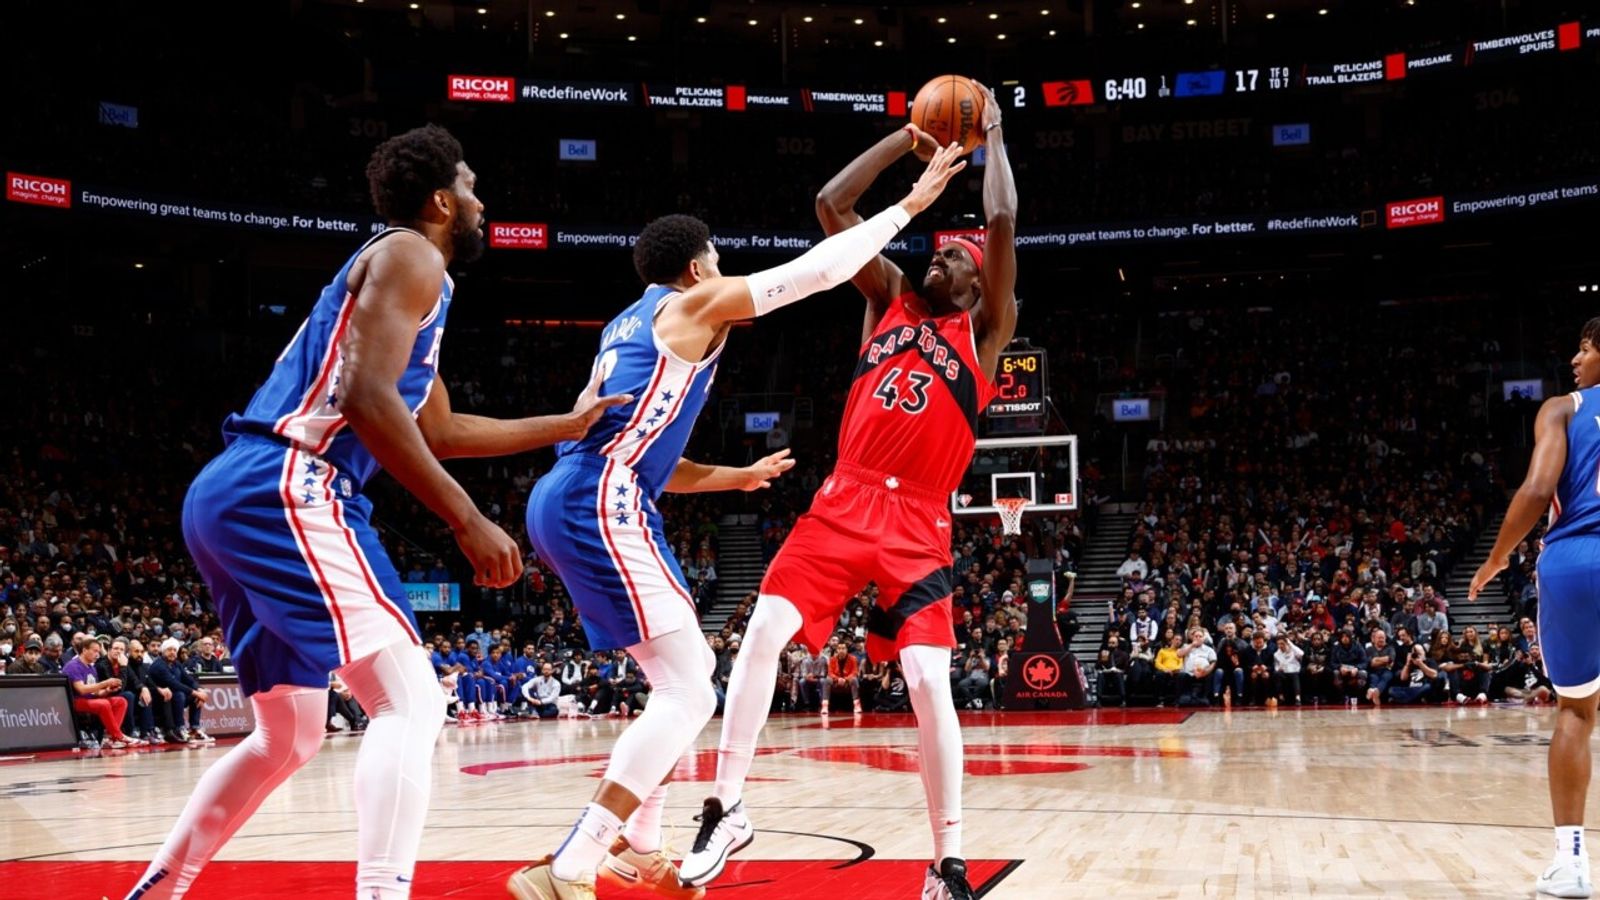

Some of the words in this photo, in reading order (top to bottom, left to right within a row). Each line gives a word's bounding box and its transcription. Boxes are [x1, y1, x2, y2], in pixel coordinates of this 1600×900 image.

[1473, 30, 1555, 51] TIMBERWOLVES
[1519, 40, 1555, 54] SPURS
[1333, 60, 1383, 73] PELICANS
[1408, 55, 1453, 69] PREGAME
[1269, 67, 1280, 78] TF
[1282, 67, 1289, 77] 0
[1306, 75, 1336, 85] TRAIL
[1338, 71, 1383, 83] BLAZERS
[452, 78, 509, 91] RICOH
[1160, 75, 1166, 88] 1
[1235, 70, 1259, 92] 17
[1269, 79, 1280, 89] TO
[1282, 78, 1289, 88] 7
[453, 91, 483, 99] imagine.
[483, 92, 510, 100] change.
[522, 85, 628, 101] #RedefineWork
[676, 87, 723, 97] PELICANS
[1105, 78, 1146, 100] 6:40
[650, 96, 678, 106] TRAIL
[680, 97, 723, 107] BLAZERS
[747, 96, 789, 104] PREGAME
[811, 92, 884, 103] TIMBERWOLVES
[1014, 86, 1025, 107] 2
[853, 103, 884, 112] SPURS
[1122, 124, 1165, 143] BAY
[1170, 117, 1253, 140] STREET
[1280, 128, 1302, 141] Bell
[568, 144, 588, 156] Bell
[12, 177, 66, 195] RICOH
[1453, 194, 1525, 213] Empowering
[1528, 189, 1559, 204] great
[1561, 184, 1598, 198] teams
[82, 191, 157, 214] Empowering
[160, 204, 190, 217] great
[193, 207, 228, 221] teams
[229, 211, 242, 222] to
[244, 212, 290, 228] change.
[292, 216, 314, 228] For
[317, 217, 358, 232] better.
[1390, 201, 1439, 217] RICOH
[1267, 214, 1358, 230] #RedefineWork
[494, 226, 543, 237] RICOH
[557, 231, 627, 246] Empowering
[1015, 231, 1066, 246] powering
[1068, 231, 1096, 244] great
[1098, 228, 1131, 240] teams
[1133, 227, 1145, 238] to
[1147, 225, 1190, 238] change.
[1192, 223, 1212, 234] For
[1215, 220, 1255, 233] better.
[751, 235, 771, 247] For
[773, 235, 812, 248] better.
[868, 325, 960, 380] RAPTORS
[1003, 356, 1036, 373] 6:40
[873, 368, 934, 414] 43
[1000, 374, 1027, 399] 2.0
[1004, 402, 1041, 412] TISSOT
[1121, 404, 1142, 416] Bell
[752, 417, 772, 428] Bell
[203, 687, 244, 711] COH
